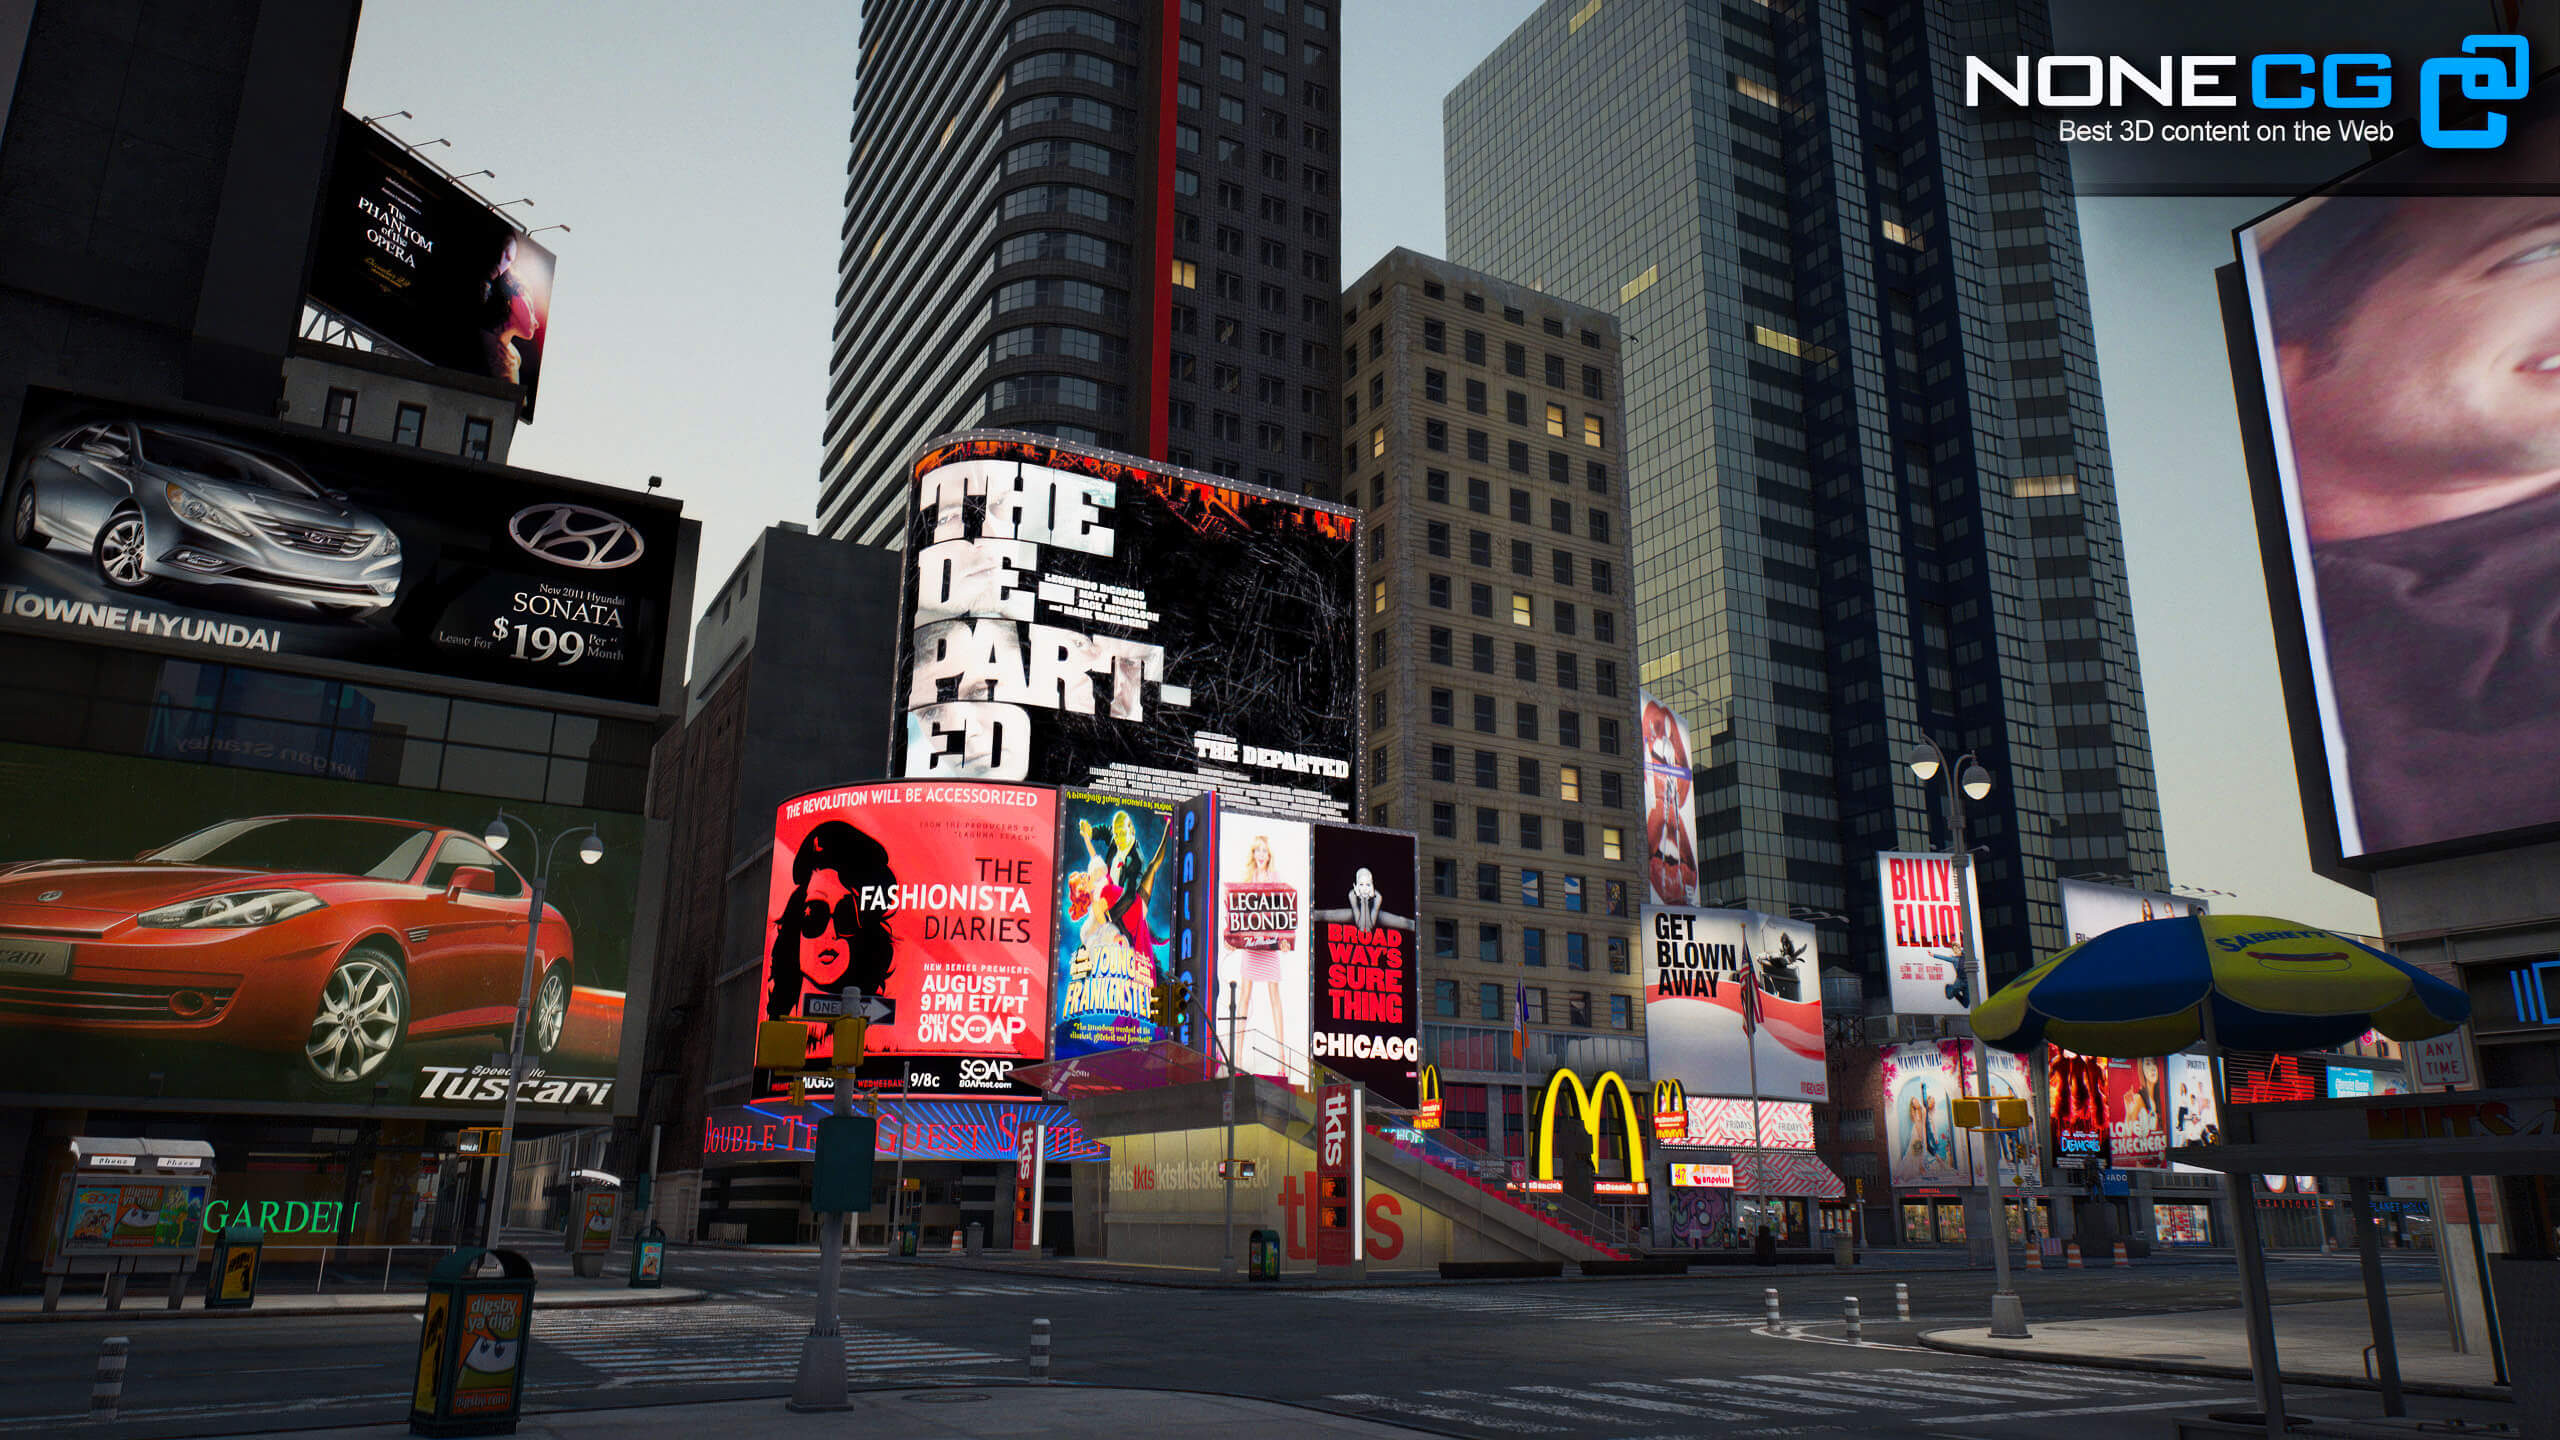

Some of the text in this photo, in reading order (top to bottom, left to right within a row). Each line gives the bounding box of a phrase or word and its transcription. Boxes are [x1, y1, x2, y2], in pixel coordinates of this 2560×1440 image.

[358, 196, 434, 253] PHANTOM
[366, 228, 416, 269] OPERA
[919, 458, 1117, 557] THE
[539, 583, 561, 595] New
[562, 587, 584, 600] 2011
[914, 537, 1038, 628] DE
[1, 584, 281, 653] TOWNE HYUNDAI
[513, 592, 624, 629] SONATA
[905, 702, 1031, 782] ED
[1194, 738, 1349, 779] THE DEPARTED
[786, 787, 1038, 820] THE REVOLUTION WILL BE ACCESSORIZED
[975, 856, 1033, 885] THE
[1889, 858, 1951, 903] BILLY
[860, 884, 1032, 914] FASHIONISTA
[1229, 891, 1297, 911] LEGALLY
[924, 915, 1031, 944] DIARIES
[1230, 911, 1297, 932] BLONDE
[1327, 923, 1403, 948] BROAD
[1655, 912, 1697, 941] GET
[924, 964, 944, 972] NEW
[980, 964, 1031, 974] PREMIERE
[1093, 946, 1136, 979] YOUNG
[1327, 943, 1403, 969] WAY'S
[1656, 940, 1737, 971] BLOWN
[921, 975, 1029, 995] AUGUST 1
[1327, 964, 1403, 993] SURE
[1658, 968, 1720, 998] AWAY
[812, 1000, 838, 1013] ONE
[920, 994, 1029, 1014] 9 PM ET/PT
[1063, 978, 1159, 1020] FRANKENSTEI
[1328, 989, 1403, 1024] THING
[917, 1015, 1026, 1044] ON SOAP
[919, 1014, 951, 1028] ONLY
[1312, 1031, 1418, 1062] CHICAGO
[2426, 1042, 2453, 1057] ANY
[910, 1073, 940, 1088] 9/8c
[960, 1059, 1014, 1081] SOAP
[2424, 1060, 2459, 1076] TIME
[420, 1066, 615, 1106] Tuscani
[875, 1113, 986, 1153] GUEST
[1325, 1092, 1347, 1167] tkts
[2111, 1134, 2168, 1155] SKECHERS
[1019, 1127, 1035, 1180] tkts
[1133, 1161, 1155, 1191] tkts
[202, 1199, 361, 1234] GARDEN
[1278, 1170, 1404, 1261] ts
[471, 1296, 518, 1317] digsby
